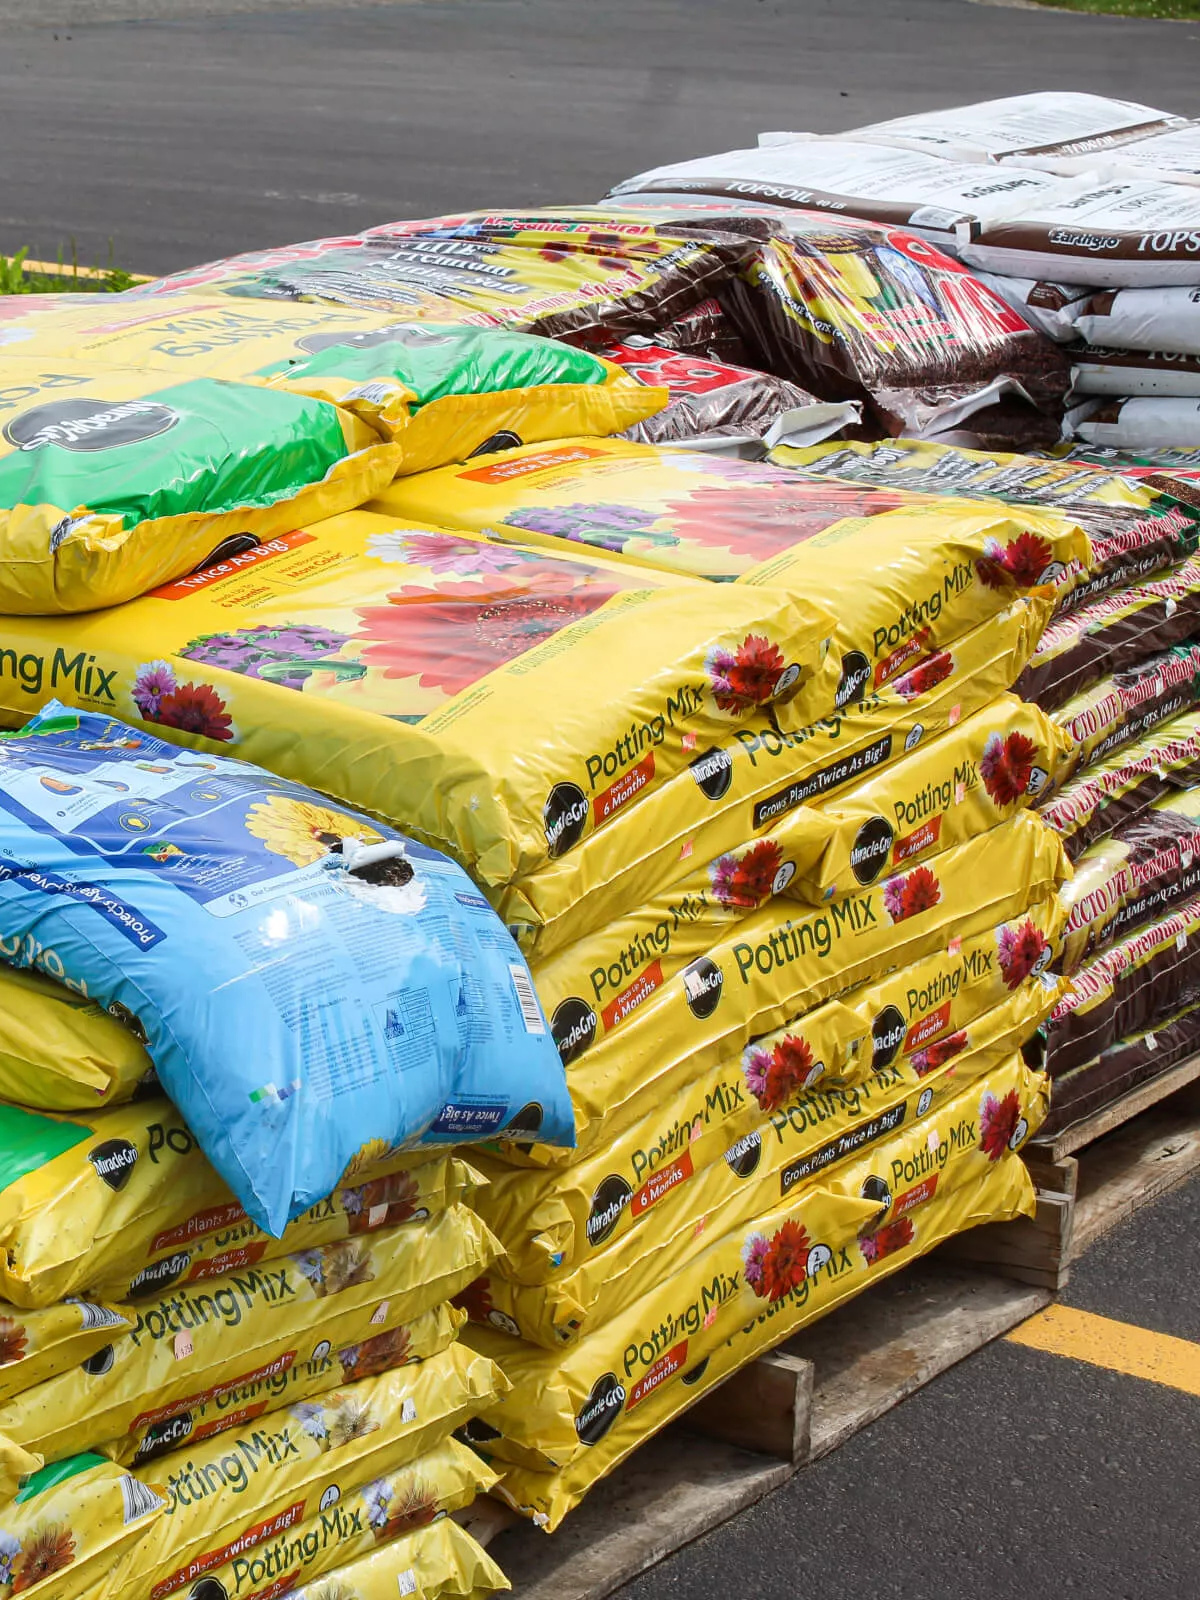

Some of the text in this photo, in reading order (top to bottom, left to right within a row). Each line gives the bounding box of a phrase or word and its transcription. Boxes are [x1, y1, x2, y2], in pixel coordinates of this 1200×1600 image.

[725, 180, 848, 210] TOPSOIL 40 LB
[1049, 229, 1122, 251] Earthgro
[173, 538, 290, 589] Twice As Big!
[287, 563, 316, 579] More
[230, 585, 272, 606] Months
[872, 559, 974, 658] Potting Mix
[50, 648, 120, 701] Mix
[1096, 691, 1119, 728] LITE
[1159, 654, 1195, 691] Potting
[584, 682, 706, 790] Potting Mix
[1143, 711, 1160, 731] QTS.
[603, 773, 647, 816] 6 Months
[758, 743, 885, 820] Grows Plants Twice As Big!
[1031, 771, 1038, 783] 2
[850, 760, 979, 867] Miracle-Gro Potting Mix
[1129, 846, 1180, 888] Premium
[1160, 886, 1181, 904] QTS.
[103, 898, 156, 944] Protects
[732, 894, 878, 985] Potting Mix
[1127, 915, 1185, 960] Premium
[589, 888, 709, 1002] Potting Mix
[613, 979, 657, 1025] 6 Months
[906, 949, 994, 1019] Potting Mix
[462, 1109, 474, 1122] As
[475, 1110, 501, 1124] Twice
[703, 1080, 745, 1124] Mix
[891, 1119, 977, 1188] Potting Mix
[640, 1168, 684, 1207] 6 Months
[783, 1166, 810, 1186] Grows
[187, 1214, 224, 1234] Plants
[813, 1250, 821, 1261] 2
[131, 1267, 297, 1348] Potting Mix
[623, 1301, 701, 1378] Potting
[699, 1268, 741, 1314] Mix
[634, 1357, 679, 1400] 6 Months
[237, 1425, 300, 1473] Mix
[231, 1505, 364, 1594] Potting Mix
[259, 1523, 274, 1541] As
